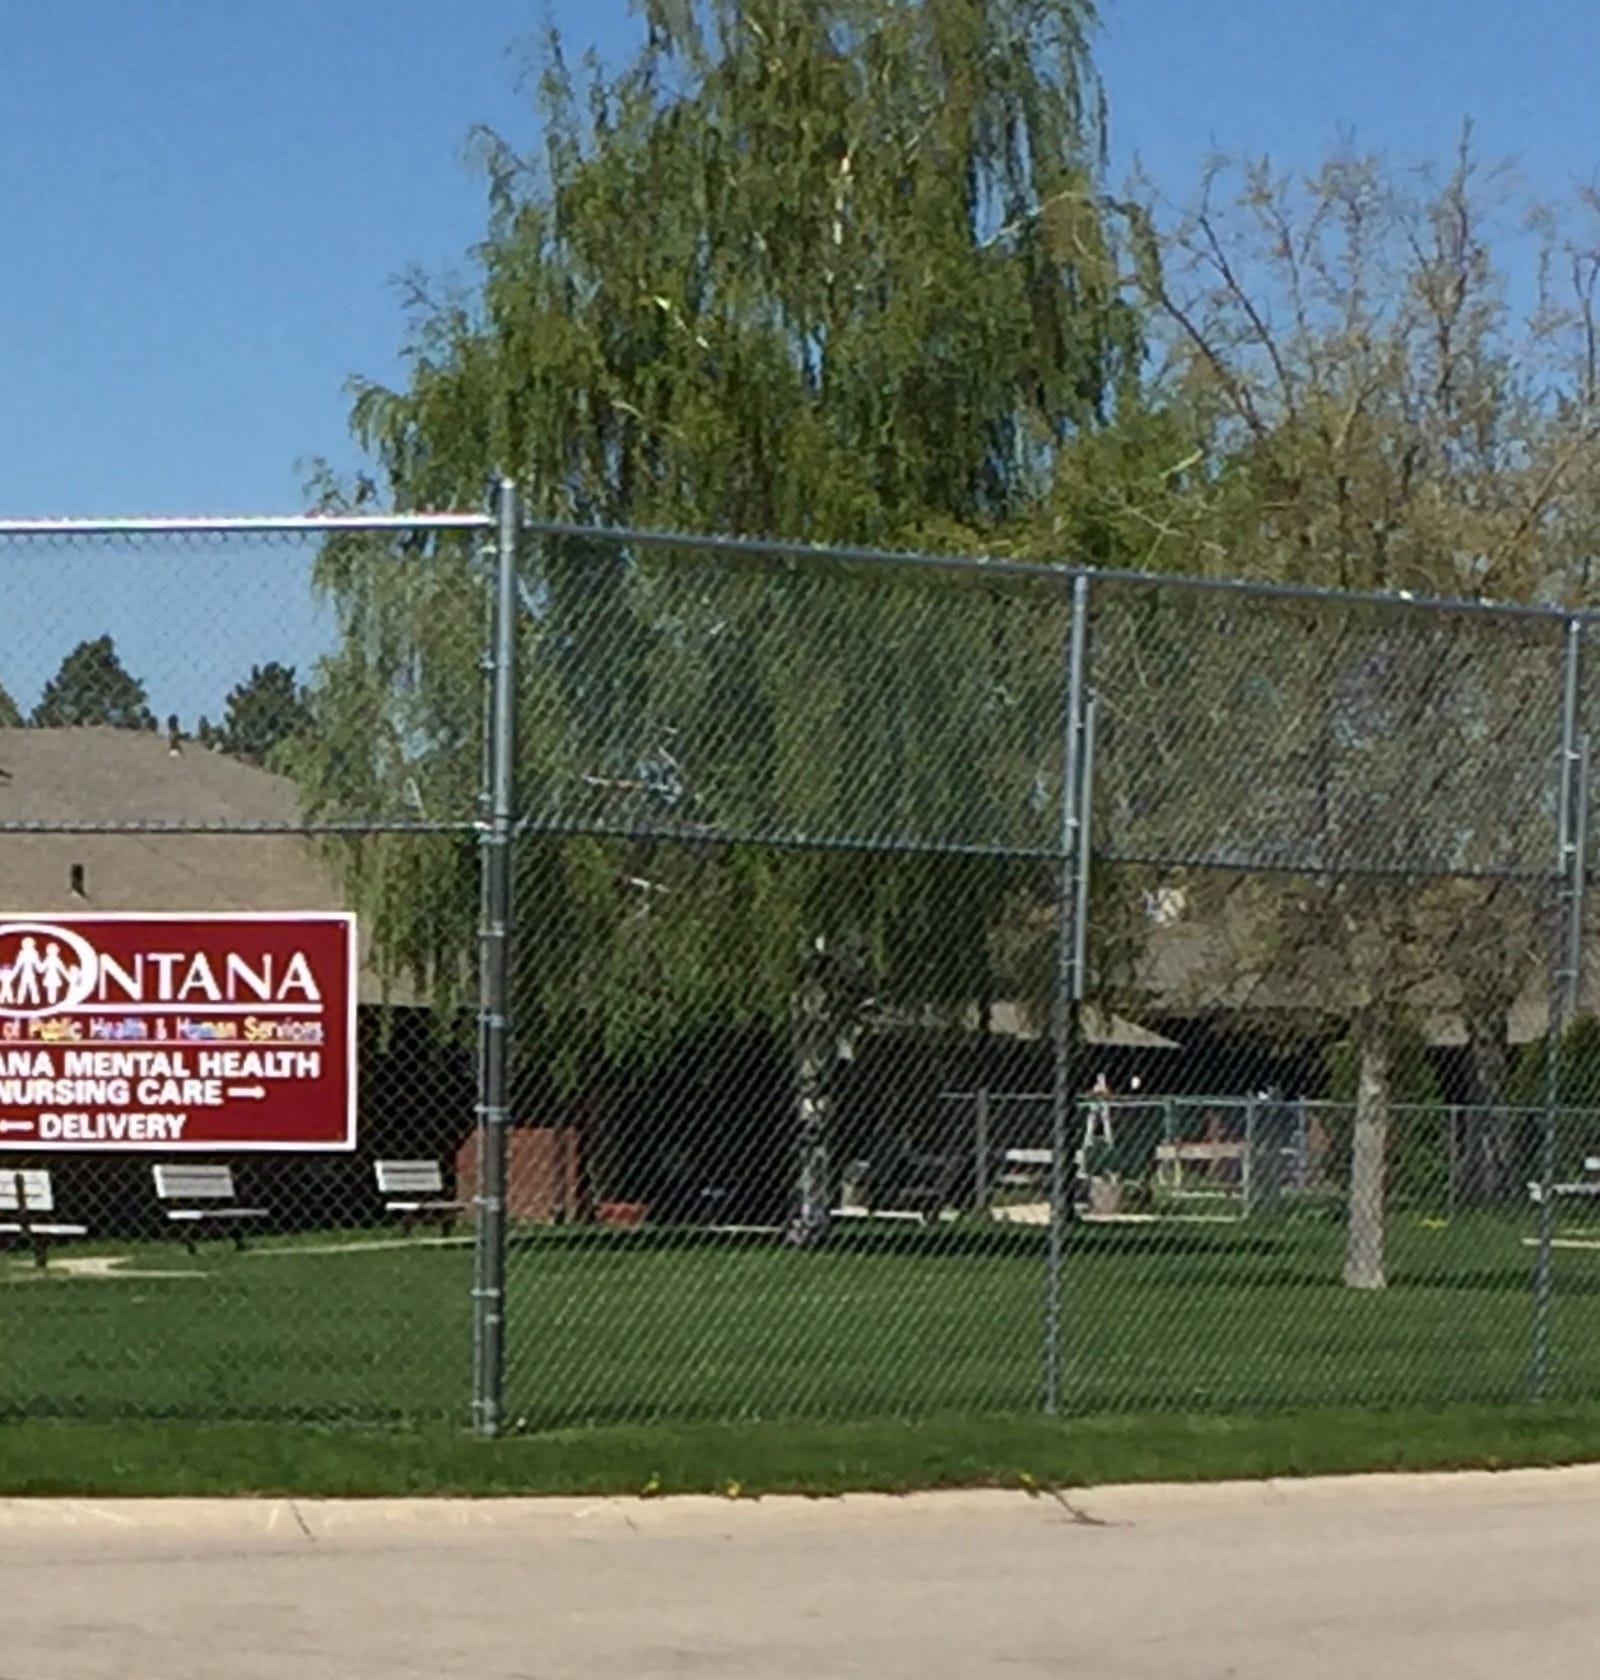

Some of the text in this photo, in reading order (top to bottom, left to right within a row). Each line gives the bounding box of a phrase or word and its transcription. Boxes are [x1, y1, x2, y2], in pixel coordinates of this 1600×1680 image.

[3, 1018, 20, 1039] of
[28, 1017, 83, 1040] Public
[90, 1017, 147, 1040] Health
[244, 1016, 324, 1040] Services
[64, 1052, 190, 1077] MENTAL
[199, 1052, 321, 1078] HEALTH
[136, 1080, 224, 1105] CARE
[39, 1113, 186, 1138] DELIVERY
